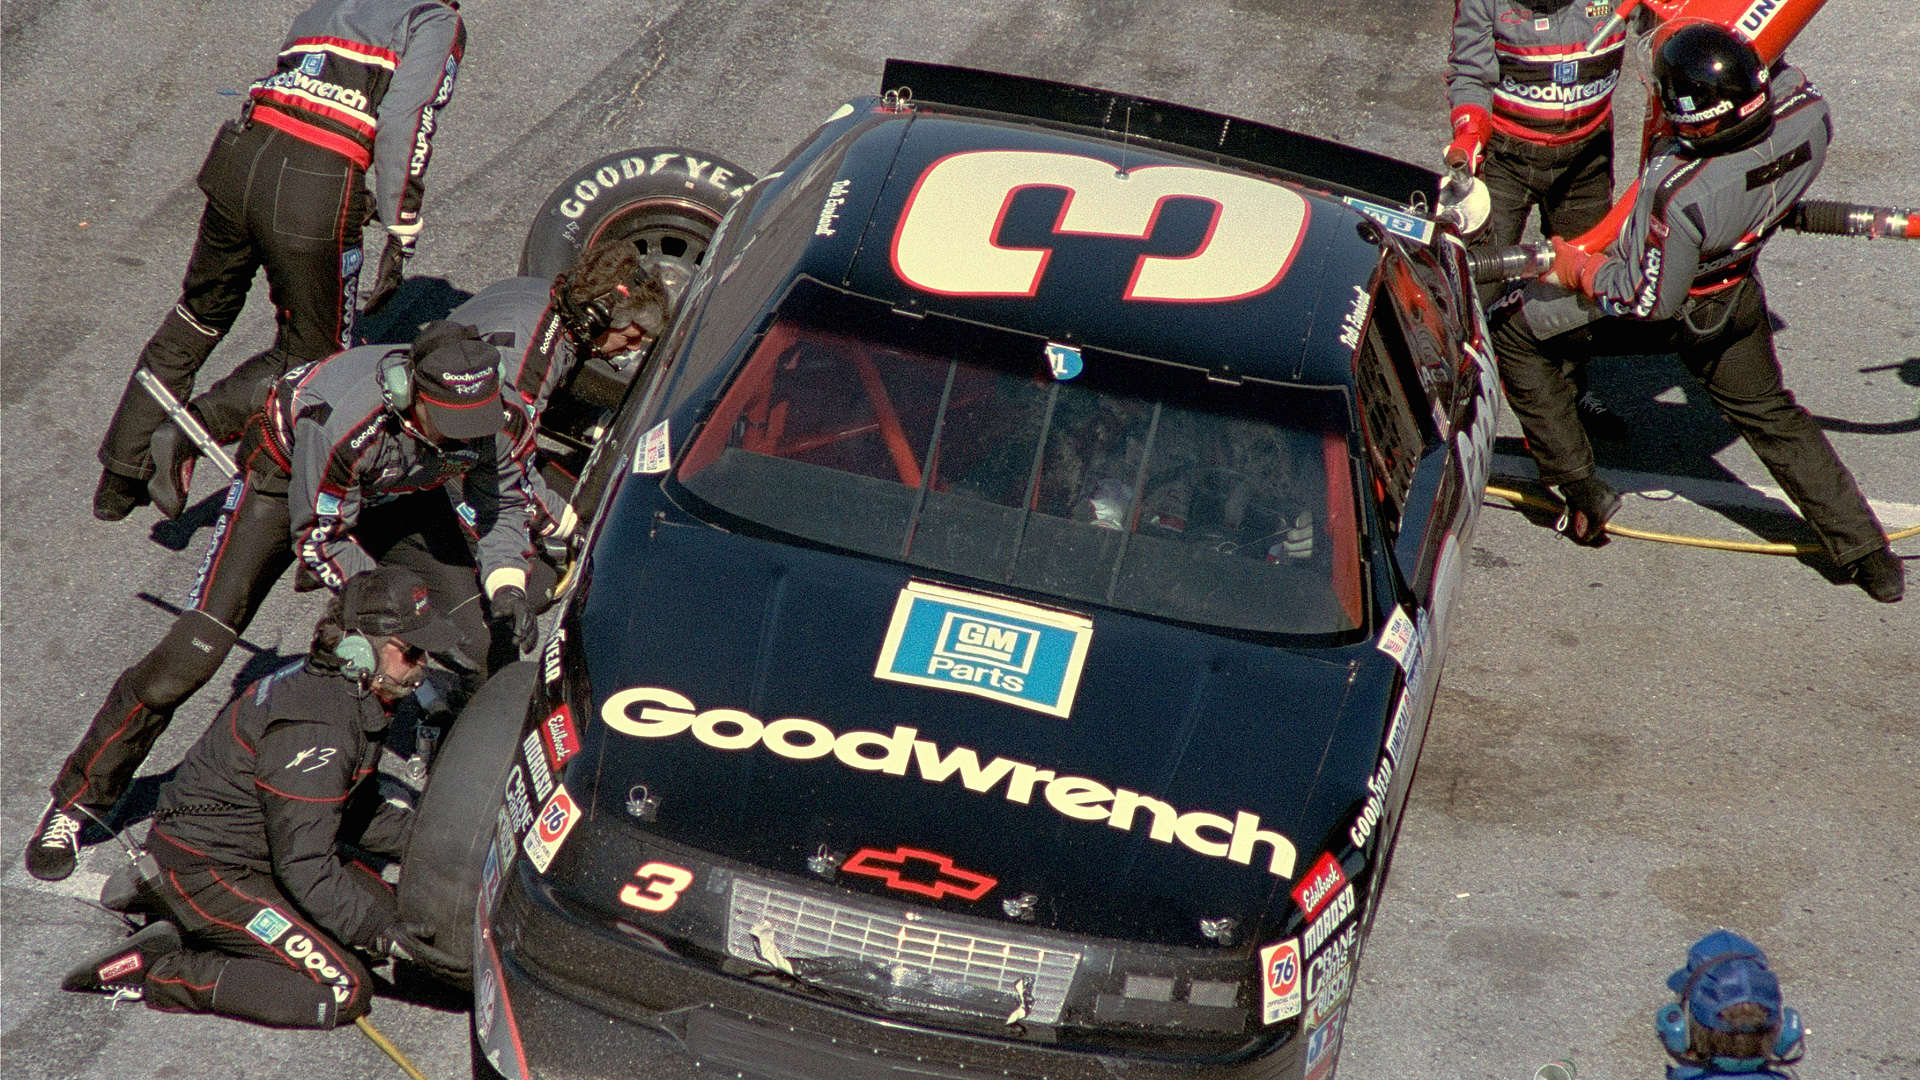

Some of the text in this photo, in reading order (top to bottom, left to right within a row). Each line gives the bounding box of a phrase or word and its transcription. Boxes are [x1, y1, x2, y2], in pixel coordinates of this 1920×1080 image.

[1502, 69, 1620, 102] Goodwrench
[815, 179, 851, 236] Dale Earnhardt
[889, 151, 1312, 303] 3
[1346, 285, 1371, 331] Earnhardt
[442, 367, 493, 381] Goodwrench
[958, 622, 1018, 653] GM
[928, 656, 1024, 692] Parts
[285, 746, 338, 773] #3
[547, 714, 571, 762] Edelbrock
[523, 729, 553, 802] MOROSO
[601, 687, 1297, 878] Goodwrench
[541, 802, 569, 835] 76
[1351, 757, 1393, 848] GOODYEAR
[620, 861, 695, 912] 3
[1303, 863, 1340, 913] Edelbrock
[1304, 883, 1355, 960] MOROSO
[1271, 952, 1296, 989] 76
